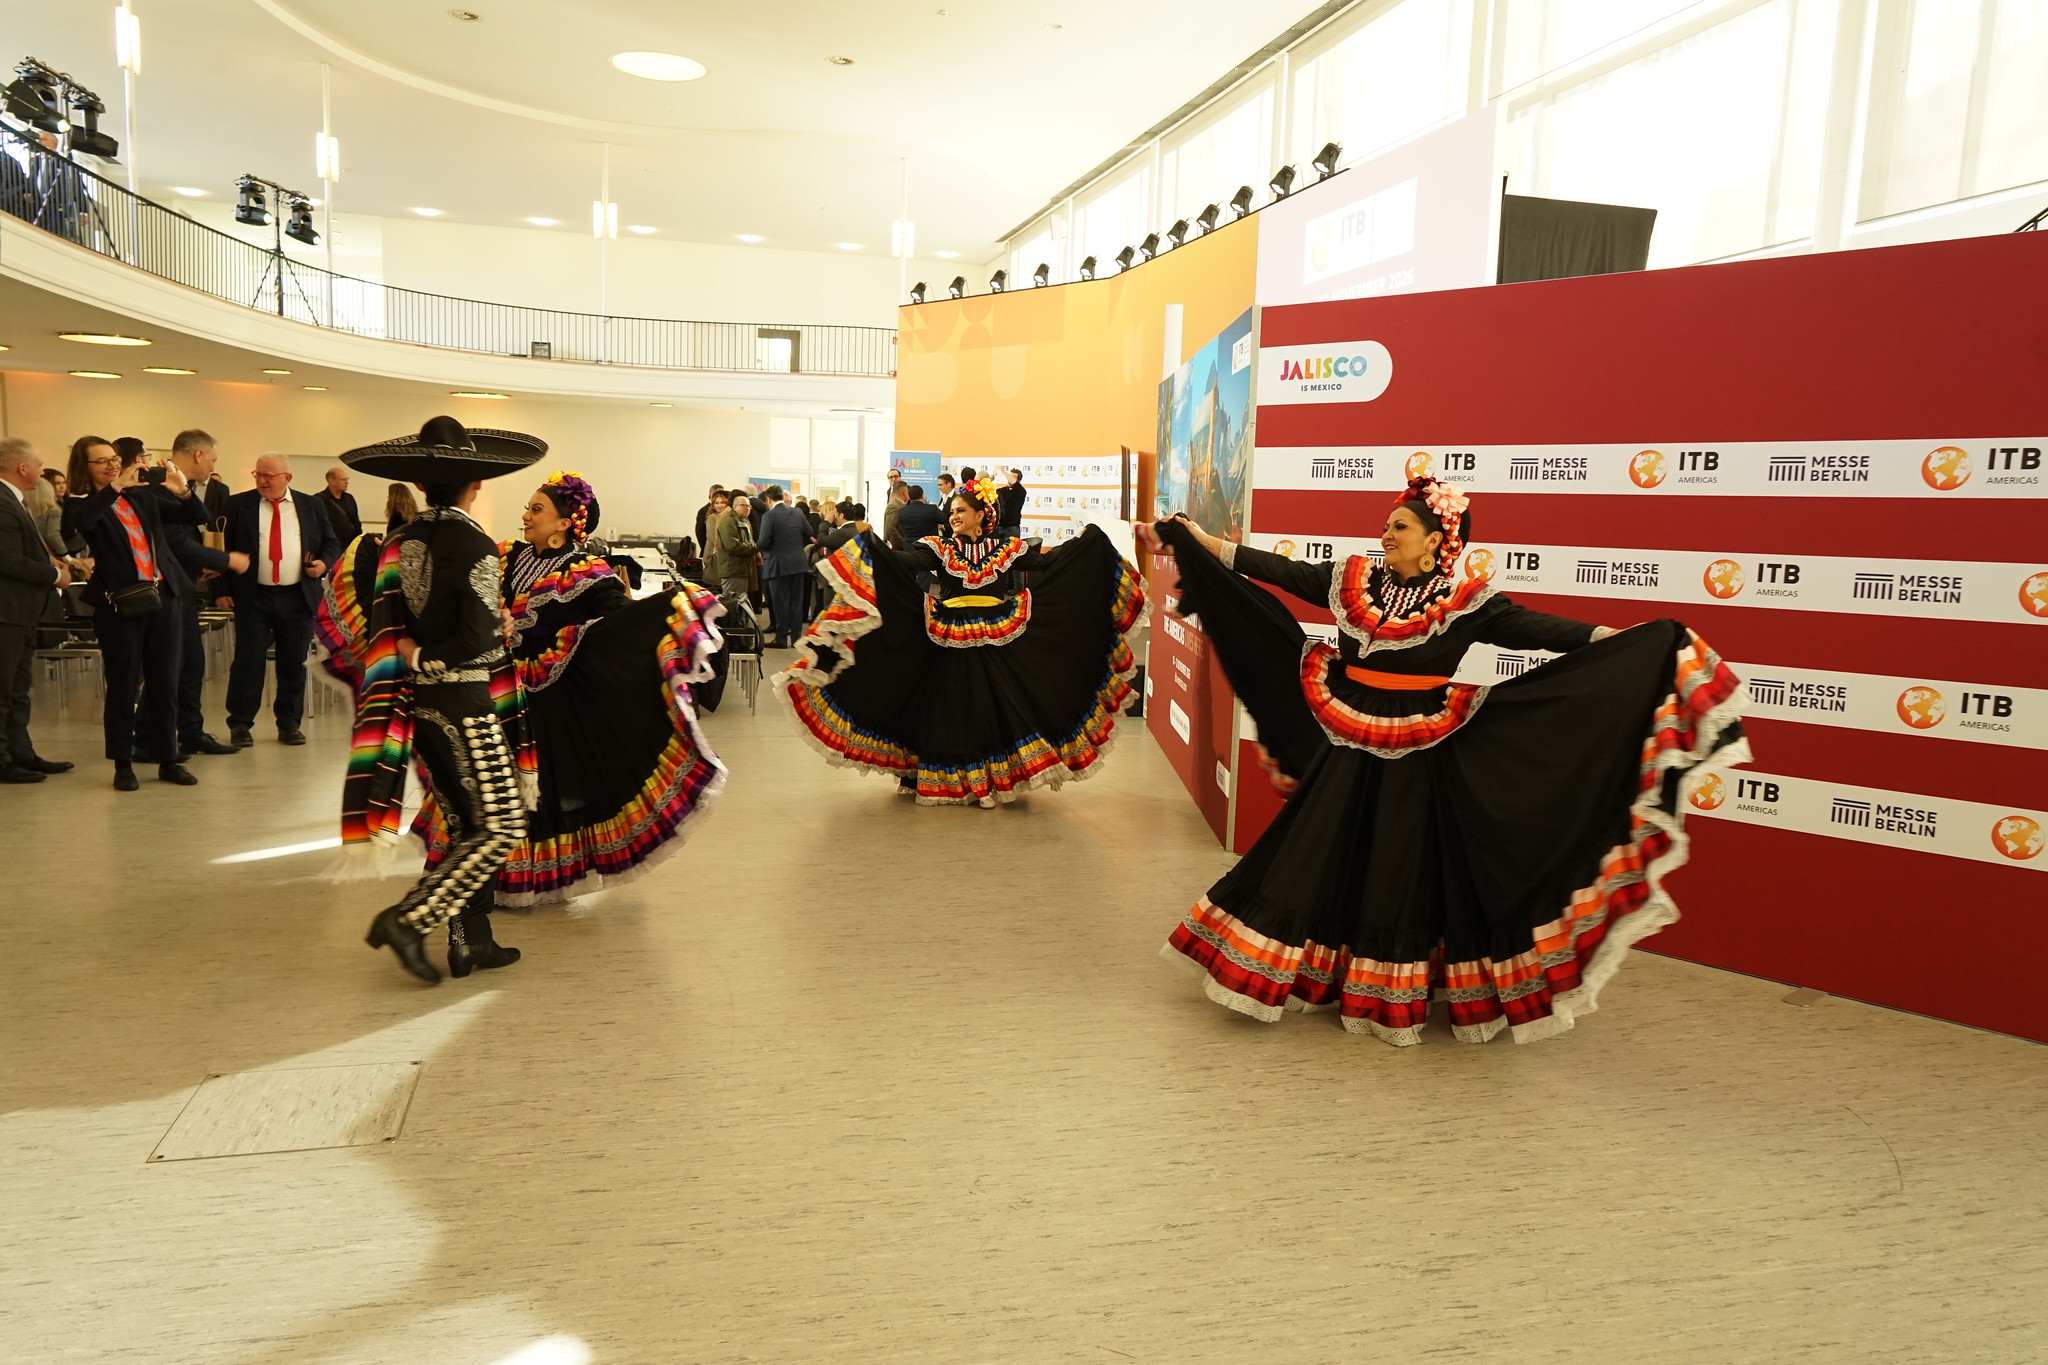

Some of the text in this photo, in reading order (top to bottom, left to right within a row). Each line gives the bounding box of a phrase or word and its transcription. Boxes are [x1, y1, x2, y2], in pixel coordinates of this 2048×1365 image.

[1341, 210, 1366, 242] ITB
[1389, 268, 1415, 294] 2026
[1280, 355, 1368, 381] JALISCO
[1310, 383, 1342, 391] MEXICO
[1338, 458, 1374, 468] MESSE
[1444, 453, 1476, 471] ITB
[1542, 457, 1588, 469] MESSE
[1678, 451, 1719, 471] ITB
[1811, 455, 1870, 468] MESSE
[1988, 447, 2041, 471] ITB
[1337, 468, 1374, 479] BERLIN
[1541, 469, 1587, 481] BERLIN
[1677, 476, 1718, 484] AMERICAS
[1810, 470, 1869, 482] BERLIN
[1986, 476, 2039, 485] AMERICAS
[1065, 528, 1075, 536] ITB
[1306, 543, 1333, 559] ITB
[1506, 552, 1540, 571] ITB
[1611, 562, 1659, 575] MESSE
[1505, 574, 1539, 582] AMERICAS
[1610, 574, 1659, 587] BERLIN
[1757, 563, 1800, 584] ITB
[1899, 575, 1963, 590] MESSE
[1756, 588, 1799, 598] AMERICAS
[1898, 589, 1962, 604] BERLIN
[1790, 682, 1847, 699] MESSE
[1788, 696, 1846, 712] BERLIN
[1961, 692, 2013, 718] ITB
[1959, 720, 2011, 732] AMERICAS
[1738, 778, 1780, 802] ITB
[1736, 803, 1778, 816] AMERICAS
[1876, 804, 1938, 824] MESSE
[1874, 817, 1937, 838] BERLIN
